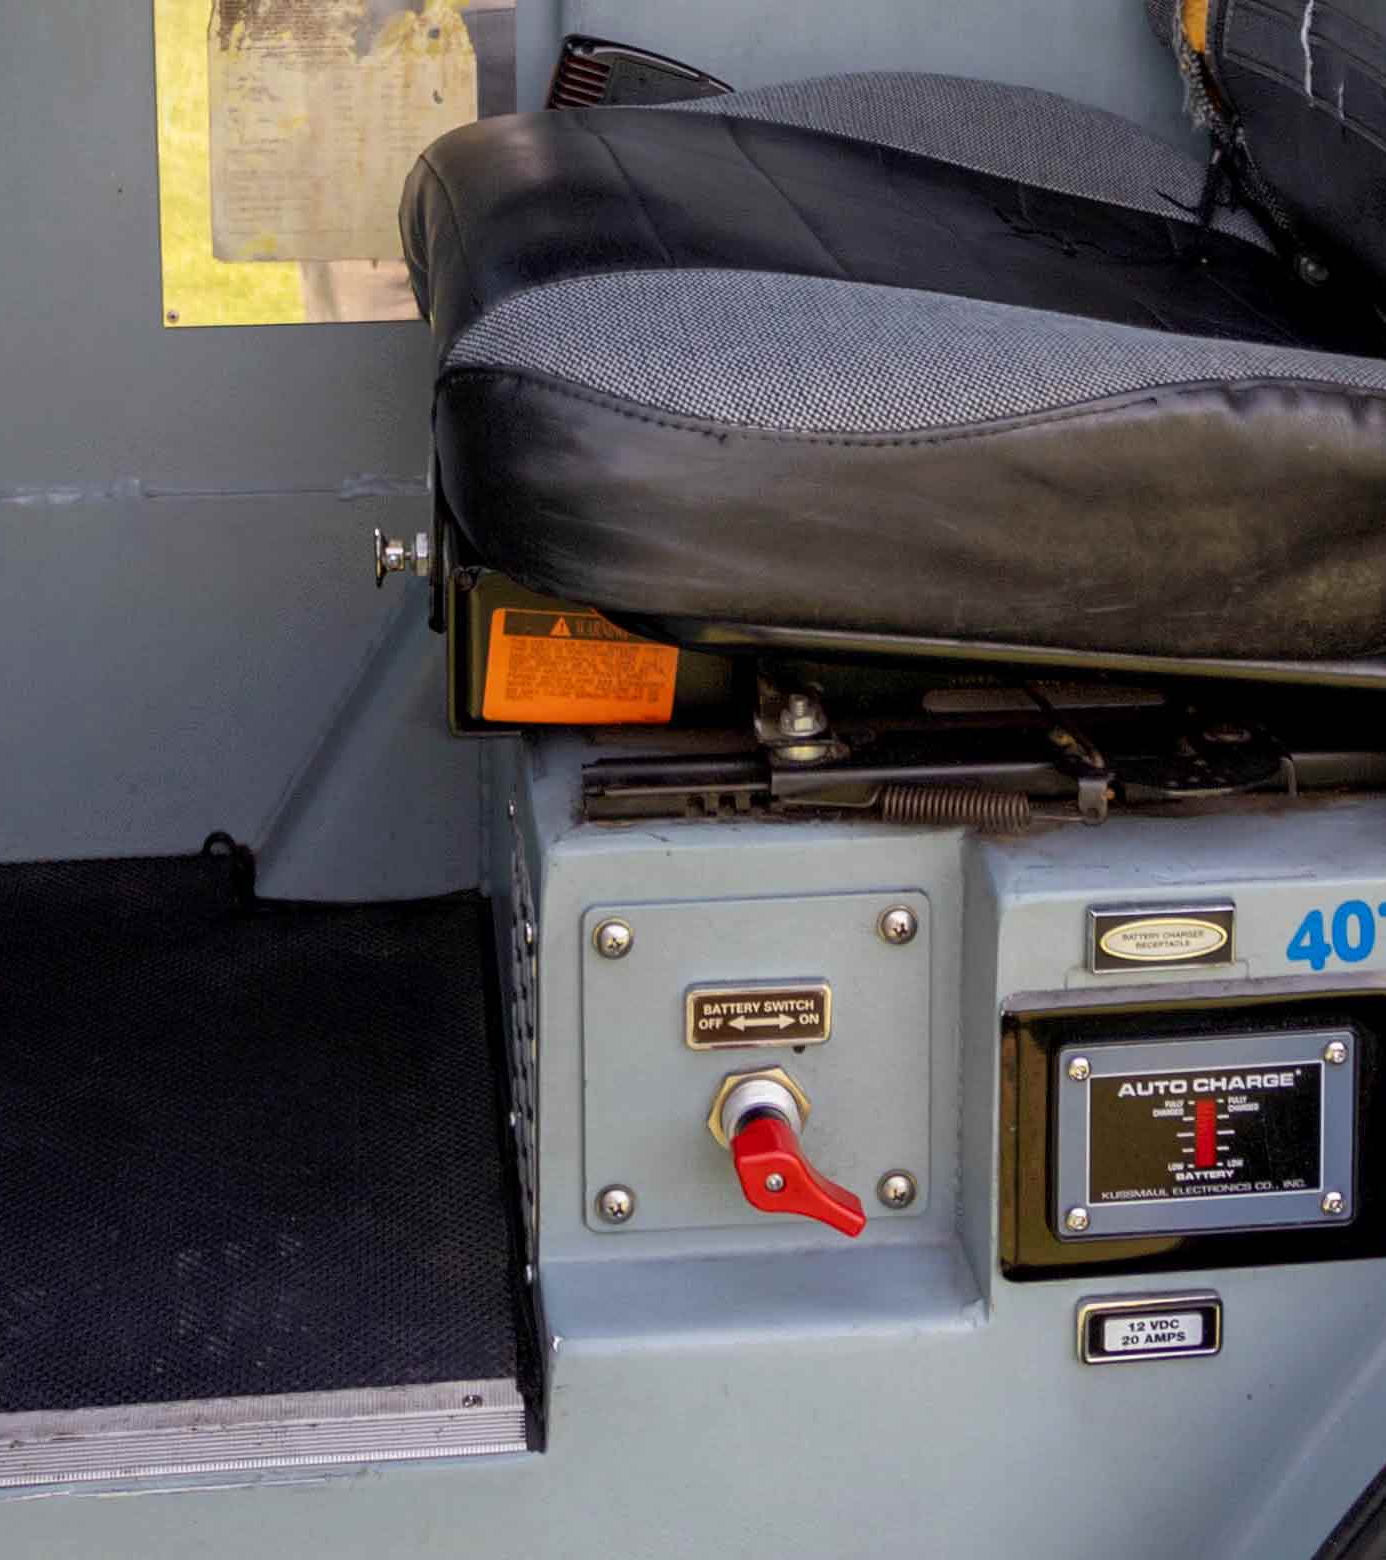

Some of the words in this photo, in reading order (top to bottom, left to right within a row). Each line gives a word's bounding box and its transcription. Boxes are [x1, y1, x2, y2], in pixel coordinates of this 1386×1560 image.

[1122, 933, 1160, 941] BATTERY
[1163, 930, 1204, 939] CHARGER
[703, 1001, 761, 1016] BATTERY
[763, 999, 814, 1012] SWITCH
[698, 1017, 724, 1030] OFF
[798, 1013, 820, 1025] ON
[1117, 1080, 1188, 1098] AUTO
[1192, 1073, 1294, 1093] CHARGE
[1227, 1159, 1244, 1168] LOW
[1175, 1169, 1234, 1181] BATTERY
[1173, 1182, 1252, 1196] ELECTRONICS
[1128, 1321, 1146, 1332] 12
[1149, 1319, 1180, 1331] VDC
[1121, 1335, 1140, 1346] 20
[1143, 1331, 1186, 1345] AMPS
